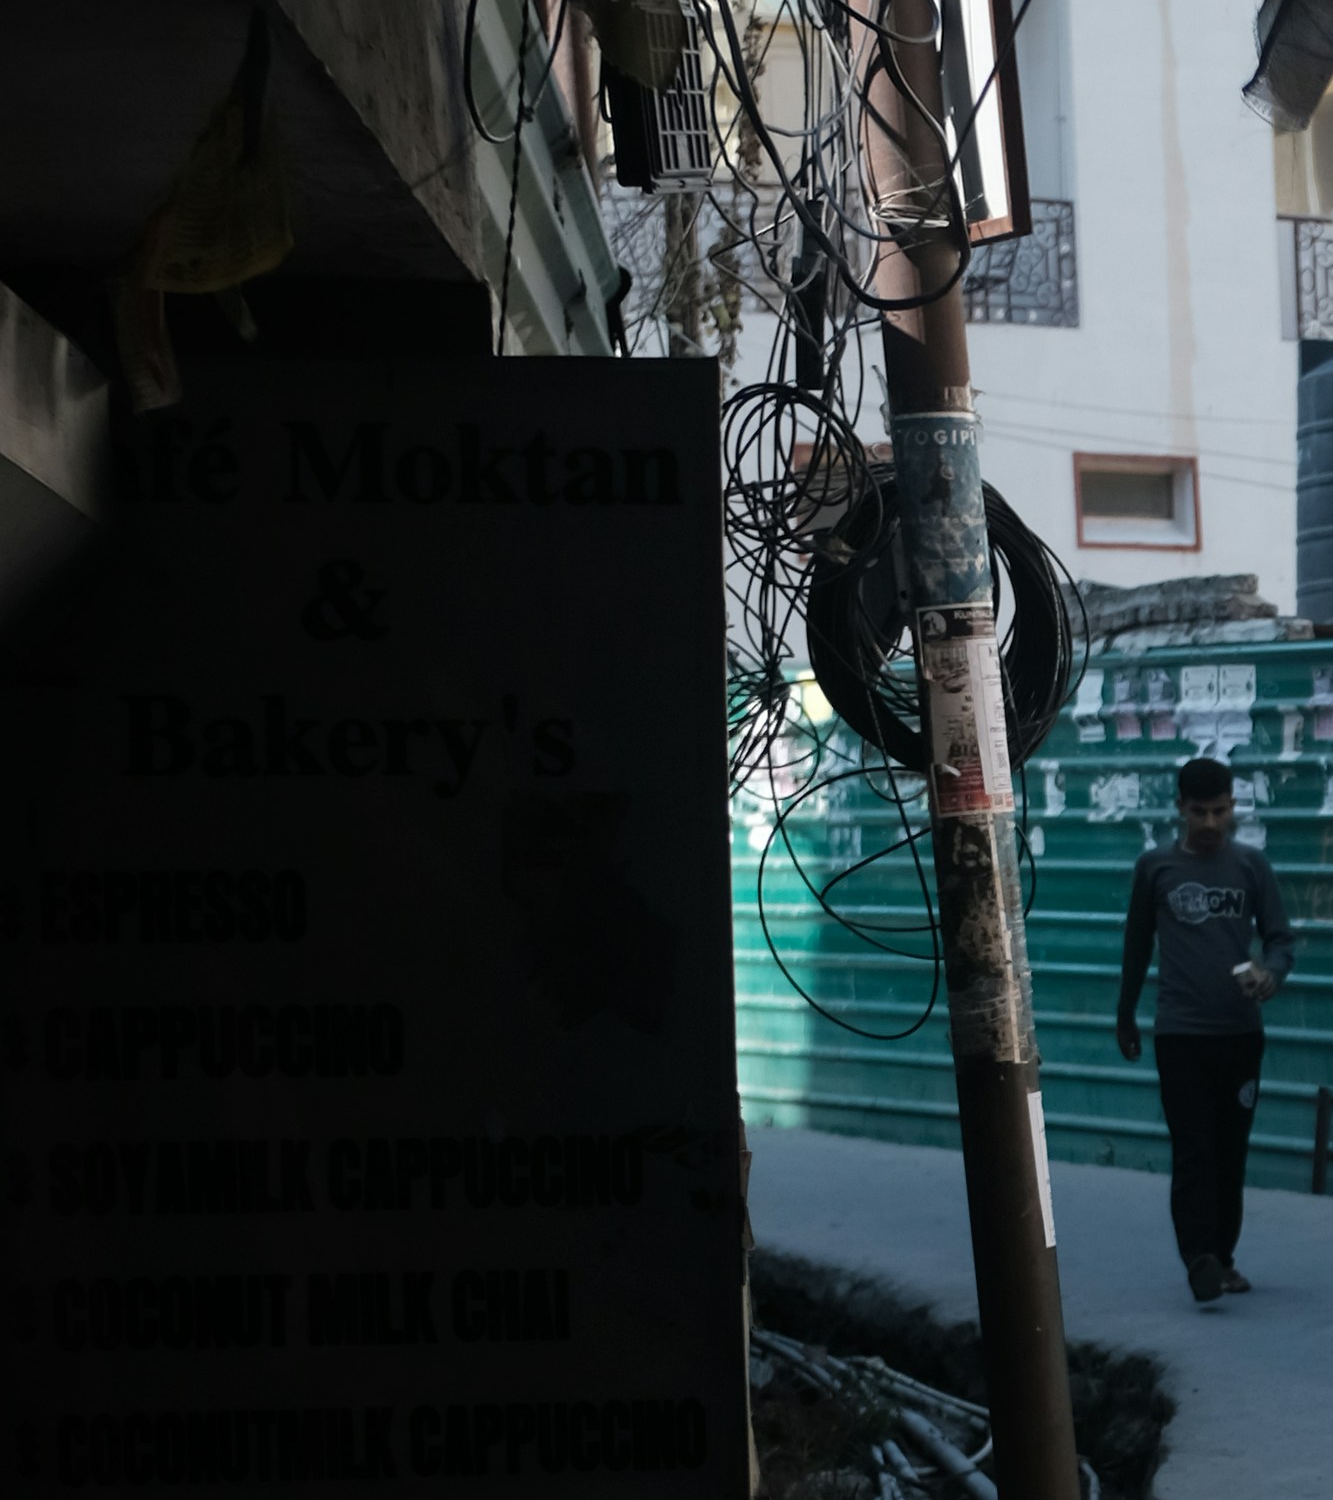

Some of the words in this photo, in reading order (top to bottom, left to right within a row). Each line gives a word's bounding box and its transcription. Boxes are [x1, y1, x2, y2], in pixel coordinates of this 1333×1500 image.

[114, 417, 238, 506] afé
[282, 420, 684, 506] Moktan
[300, 557, 392, 641] &
[122, 694, 576, 797] Bakery's
[41, 870, 307, 943] ESPRESSO
[42, 1003, 404, 1079] CAPPUCCINO
[48, 1138, 316, 1213] SOYAMILK
[329, 1133, 644, 1211] CAPPUCCINO
[52, 1274, 298, 1350] COCONUT
[308, 1268, 438, 1347] MILK
[451, 1266, 571, 1343] CHAI
[408, 1398, 708, 1476] CAPPUCCINO
